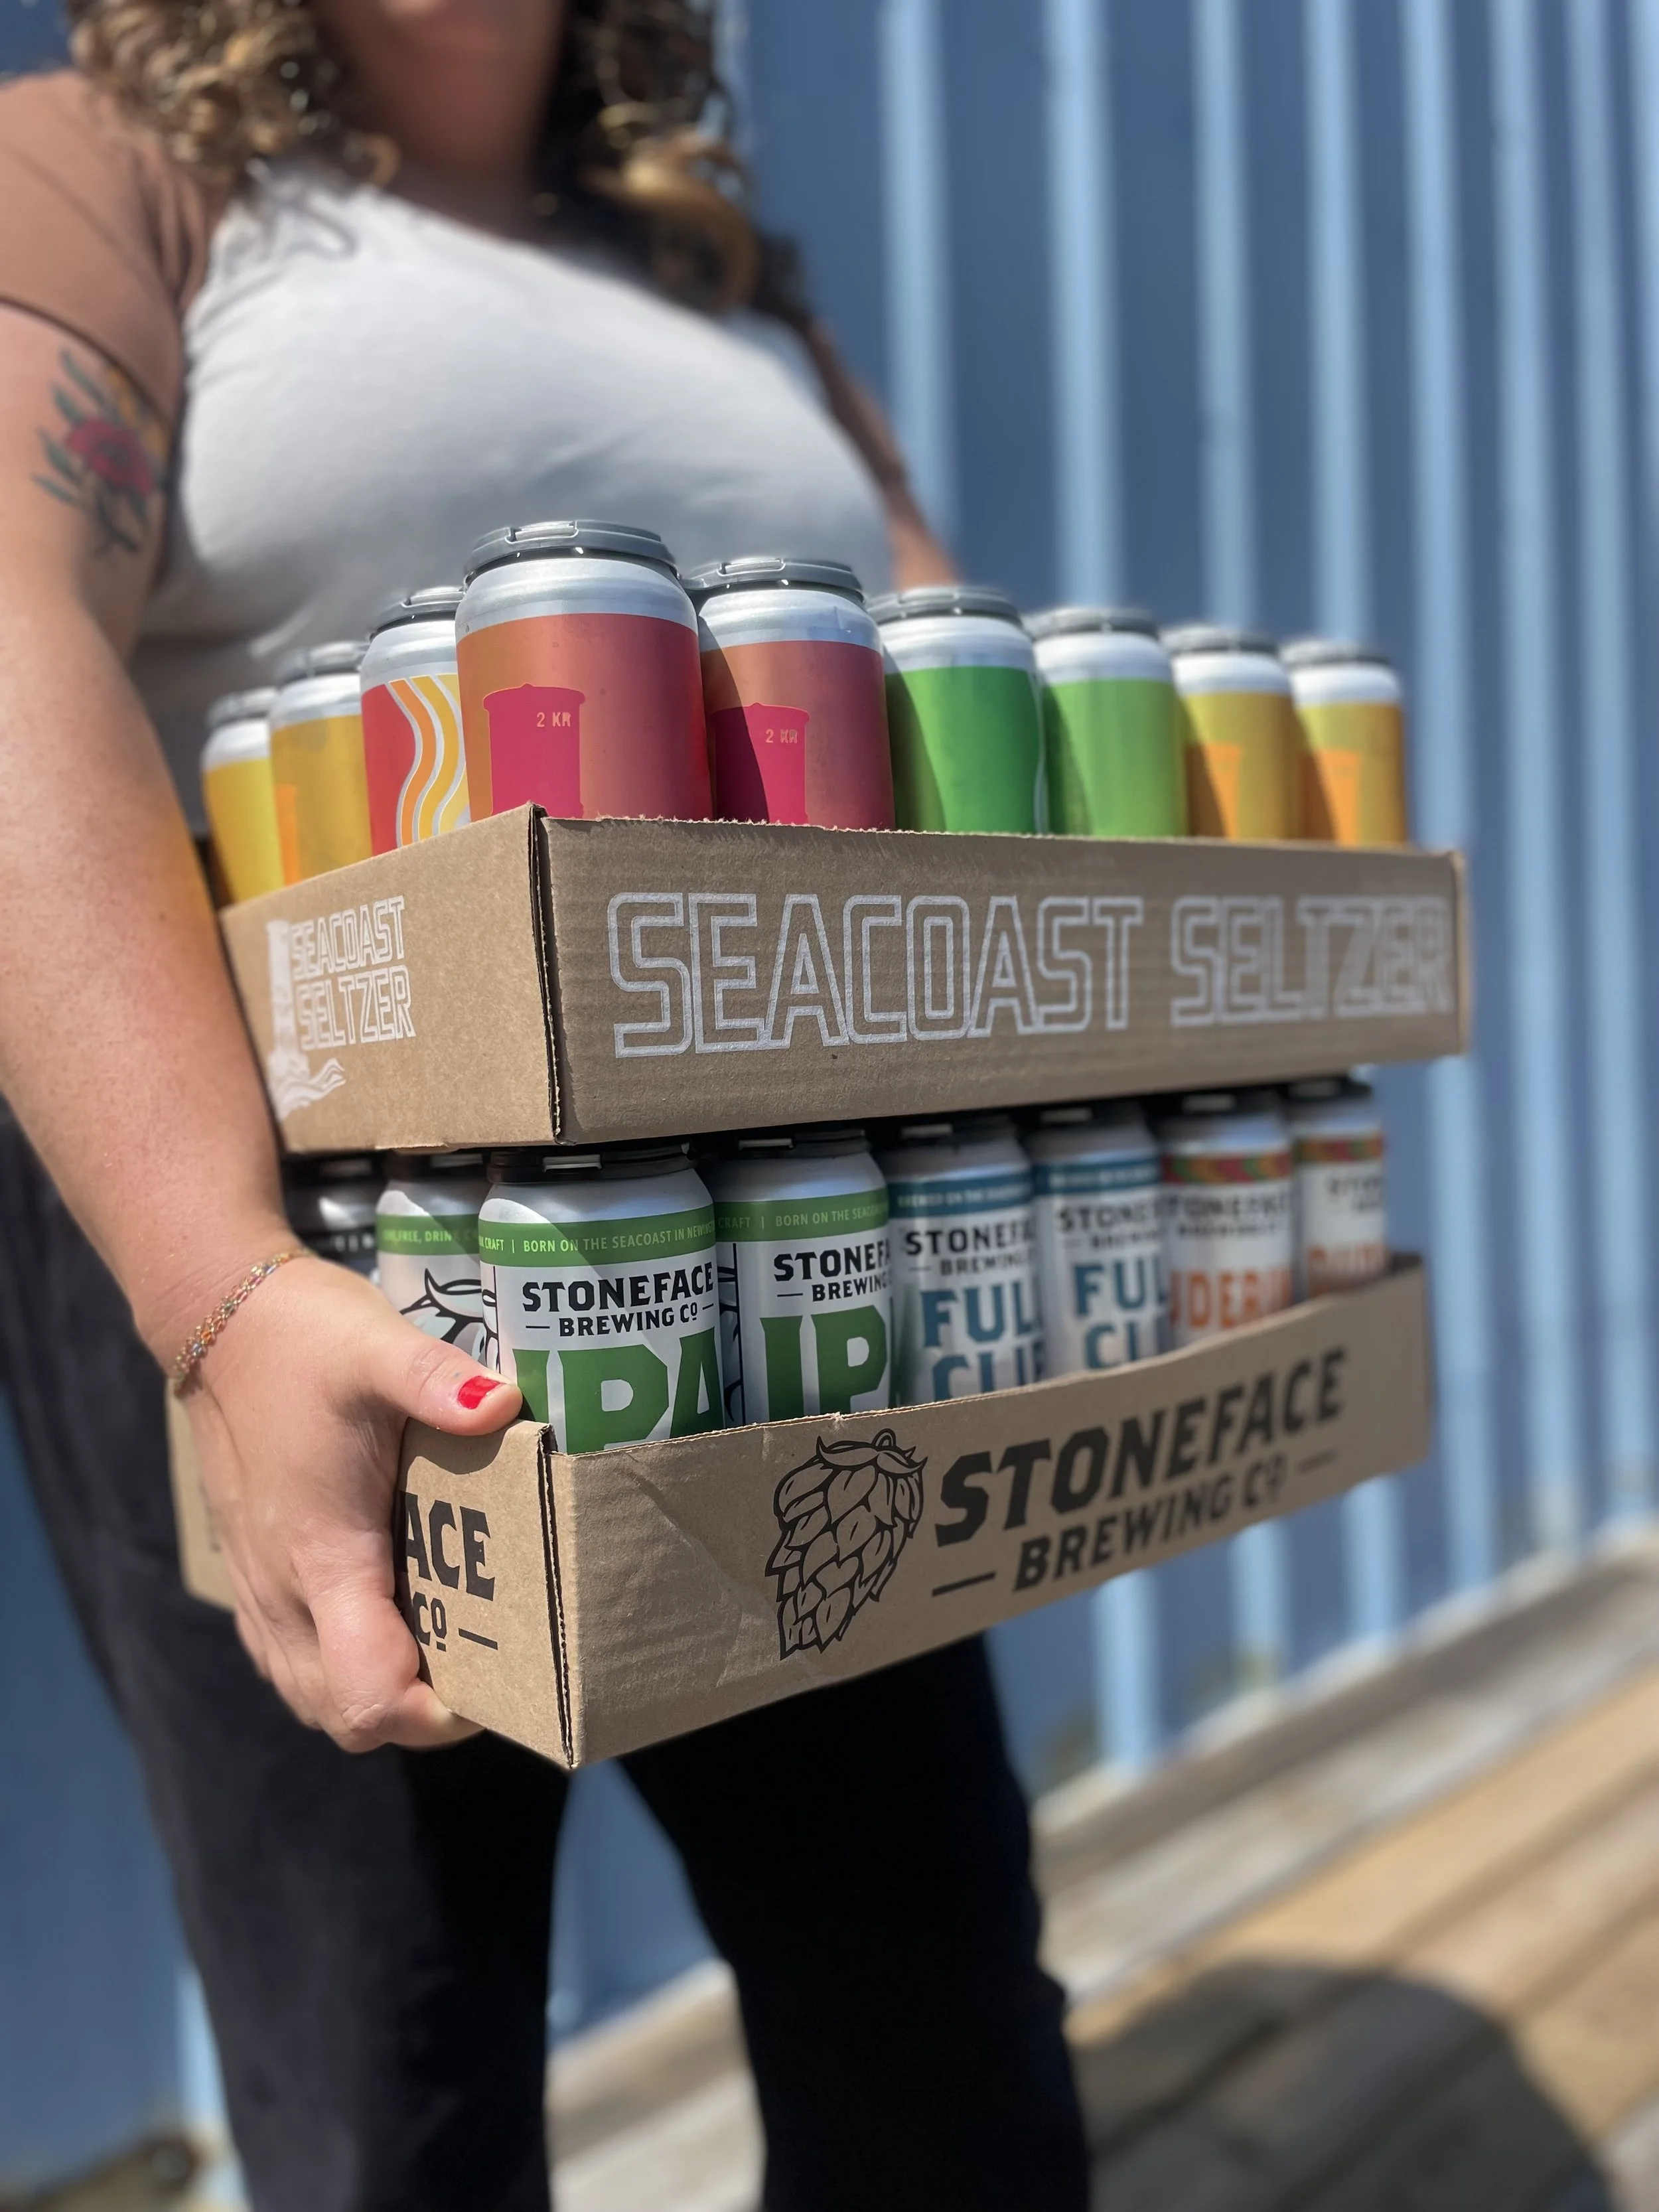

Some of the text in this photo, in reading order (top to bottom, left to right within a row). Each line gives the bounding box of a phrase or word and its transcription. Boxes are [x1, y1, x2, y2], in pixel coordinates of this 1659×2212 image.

[537, 711, 571, 727] 2 KR
[766, 729, 798, 743] 2 KR
[291, 895, 405, 981] SEACOAST
[296, 965, 416, 1051] SELTZER
[608, 892, 1454, 1058] SEACOAST SELTZER
[484, 1237, 504, 1251] CRAFT
[524, 1240, 555, 1252] BORN
[560, 1238, 579, 1252] ON
[583, 1237, 607, 1250] THE
[612, 1229, 672, 1249] SEACOAST
[675, 1228, 684, 1241] IN
[719, 1217, 751, 1228] CRAFT
[776, 1214, 808, 1226] BORN
[812, 1212, 828, 1224] ON
[831, 1209, 849, 1222] THE
[522, 1262, 714, 1312] STONEFACE
[559, 1306, 675, 1337] BREWING
[512, 1327, 725, 1454] IPA
[936, 1346, 1350, 1548] STONEFACE
[1013, 1472, 1232, 1592] BREWING
